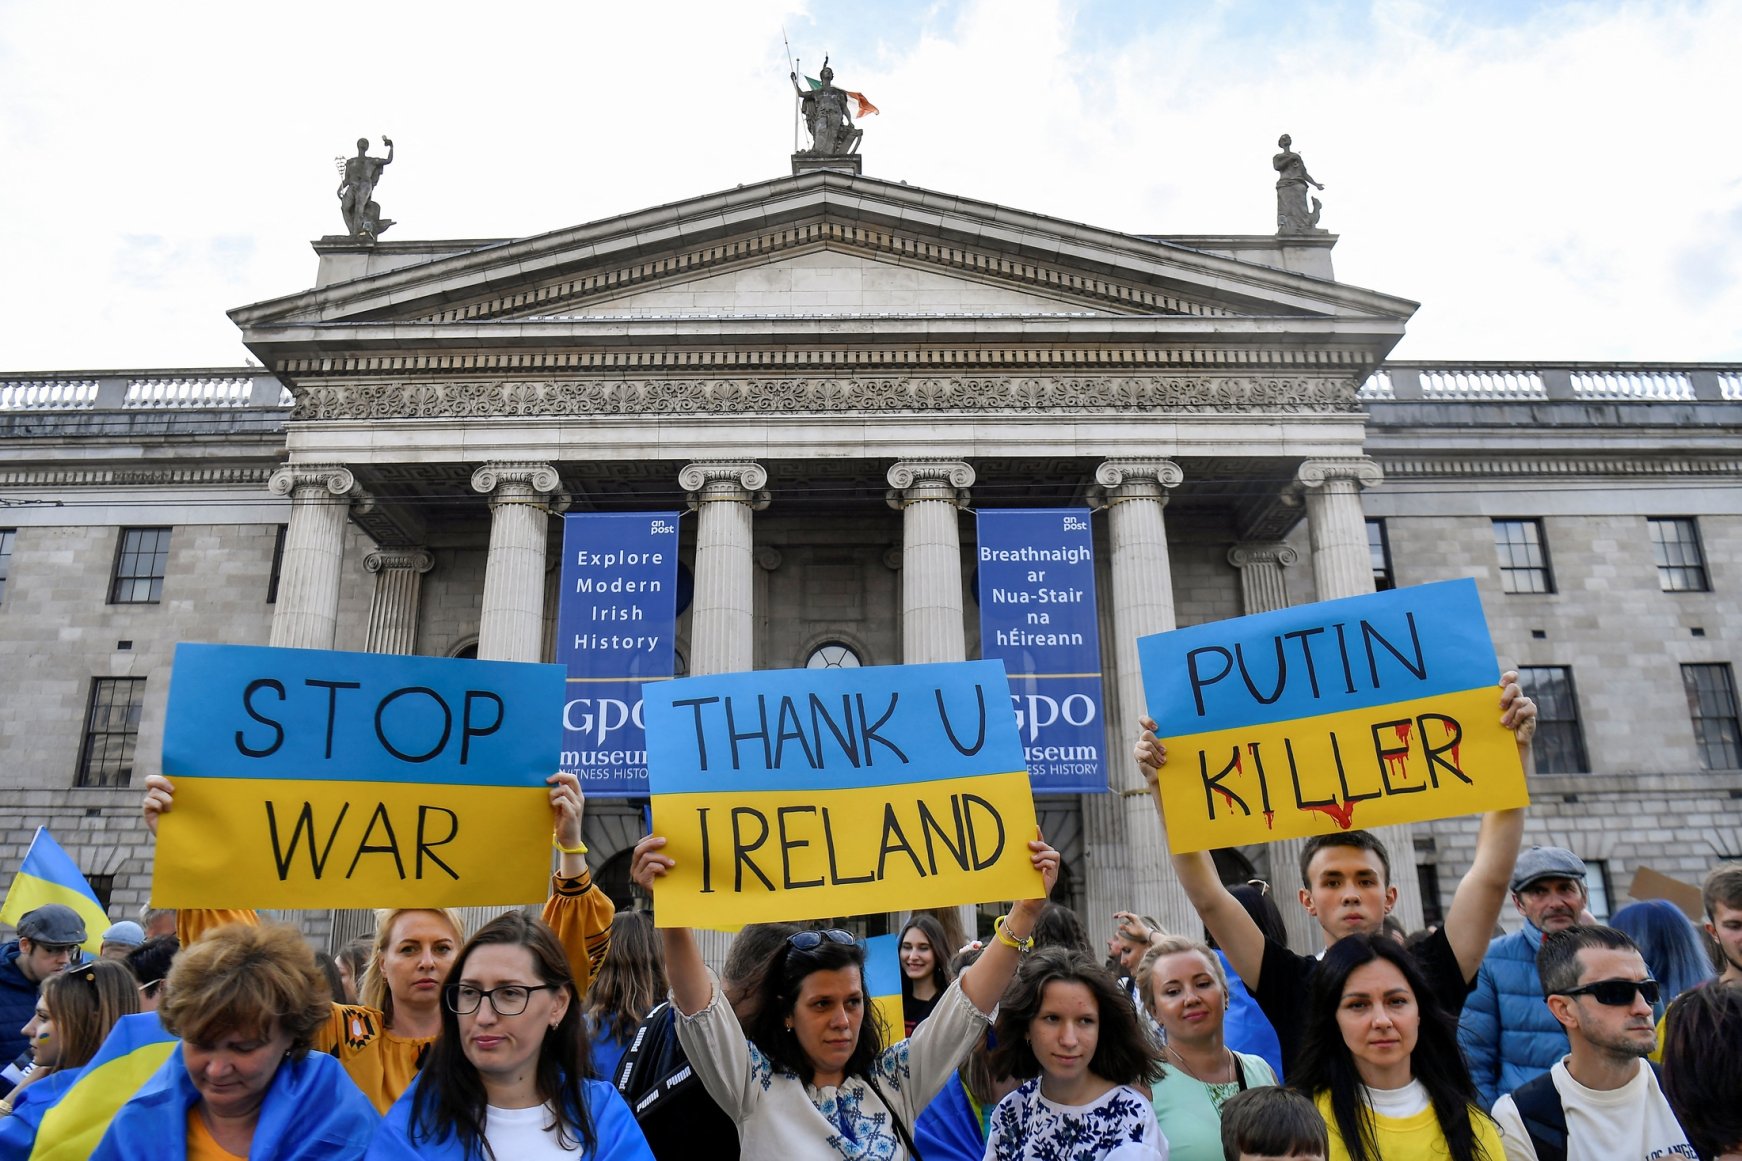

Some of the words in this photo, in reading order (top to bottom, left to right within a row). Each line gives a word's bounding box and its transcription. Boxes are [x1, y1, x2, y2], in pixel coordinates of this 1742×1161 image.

[651, 525, 674, 535] post
[1063, 522, 1087, 532] post
[577, 550, 663, 568] Explore
[980, 545, 1091, 563] Breathnaigh
[1027, 569, 1046, 582] ar
[576, 578, 661, 593] Modern
[992, 588, 1083, 603] Nua-Stair
[592, 605, 643, 621] Irish
[1027, 612, 1050, 625] na
[574, 634, 659, 653] History
[996, 627, 1083, 646] hÉireann
[1186, 611, 1427, 717] PUTIN
[235, 678, 505, 765] STOP
[672, 692, 909, 771] THANK
[935, 684, 987, 756] U
[614, 768, 648, 779] HISTO
[1050, 763, 1098, 775] HISTORY
[1199, 713, 1473, 820] KILLER
[264, 800, 460, 881] WAR
[696, 793, 1006, 893] IRELAND
[631, 1026, 647, 1053] PUMA
[618, 1061, 634, 1090] PUMA
[666, 1065, 692, 1090] PUMA
[636, 1088, 660, 1113] PUMA
[1667, 1143, 1698, 1160] ANGE
